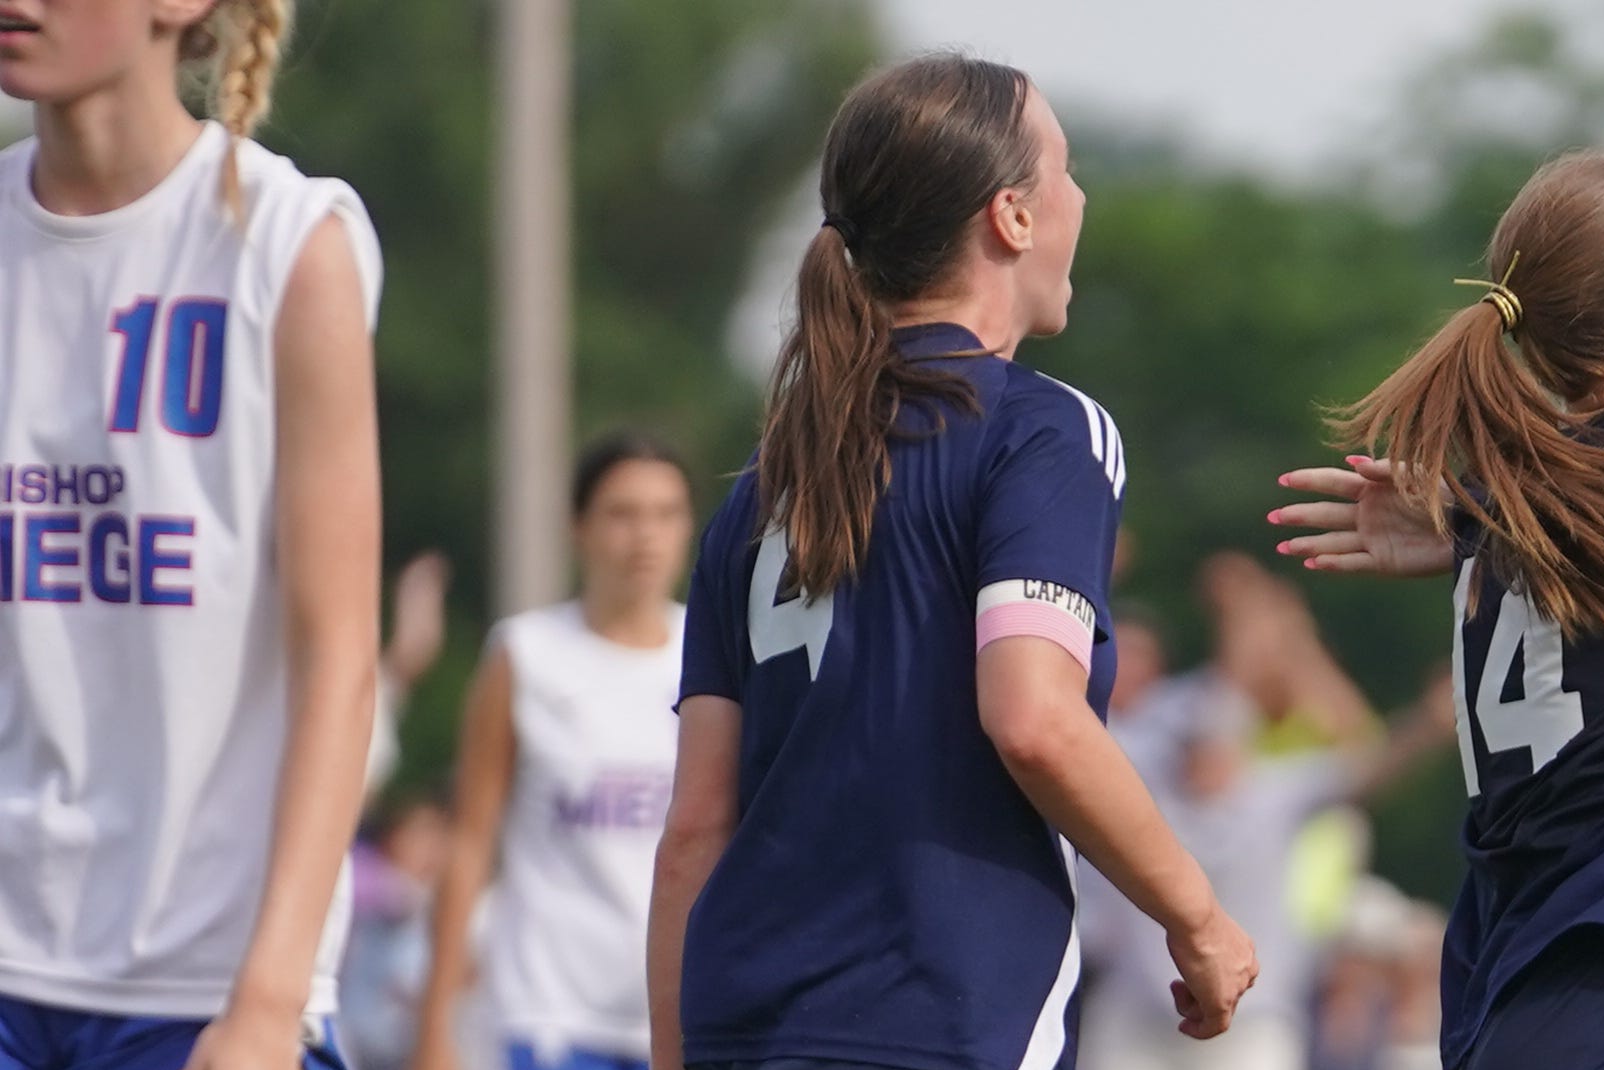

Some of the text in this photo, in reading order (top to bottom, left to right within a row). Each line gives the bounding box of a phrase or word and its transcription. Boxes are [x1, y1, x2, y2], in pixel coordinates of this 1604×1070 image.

[108, 295, 228, 438] 10
[1023, 579, 1092, 632] CAPTAIN
[1452, 556, 1585, 798] 14
